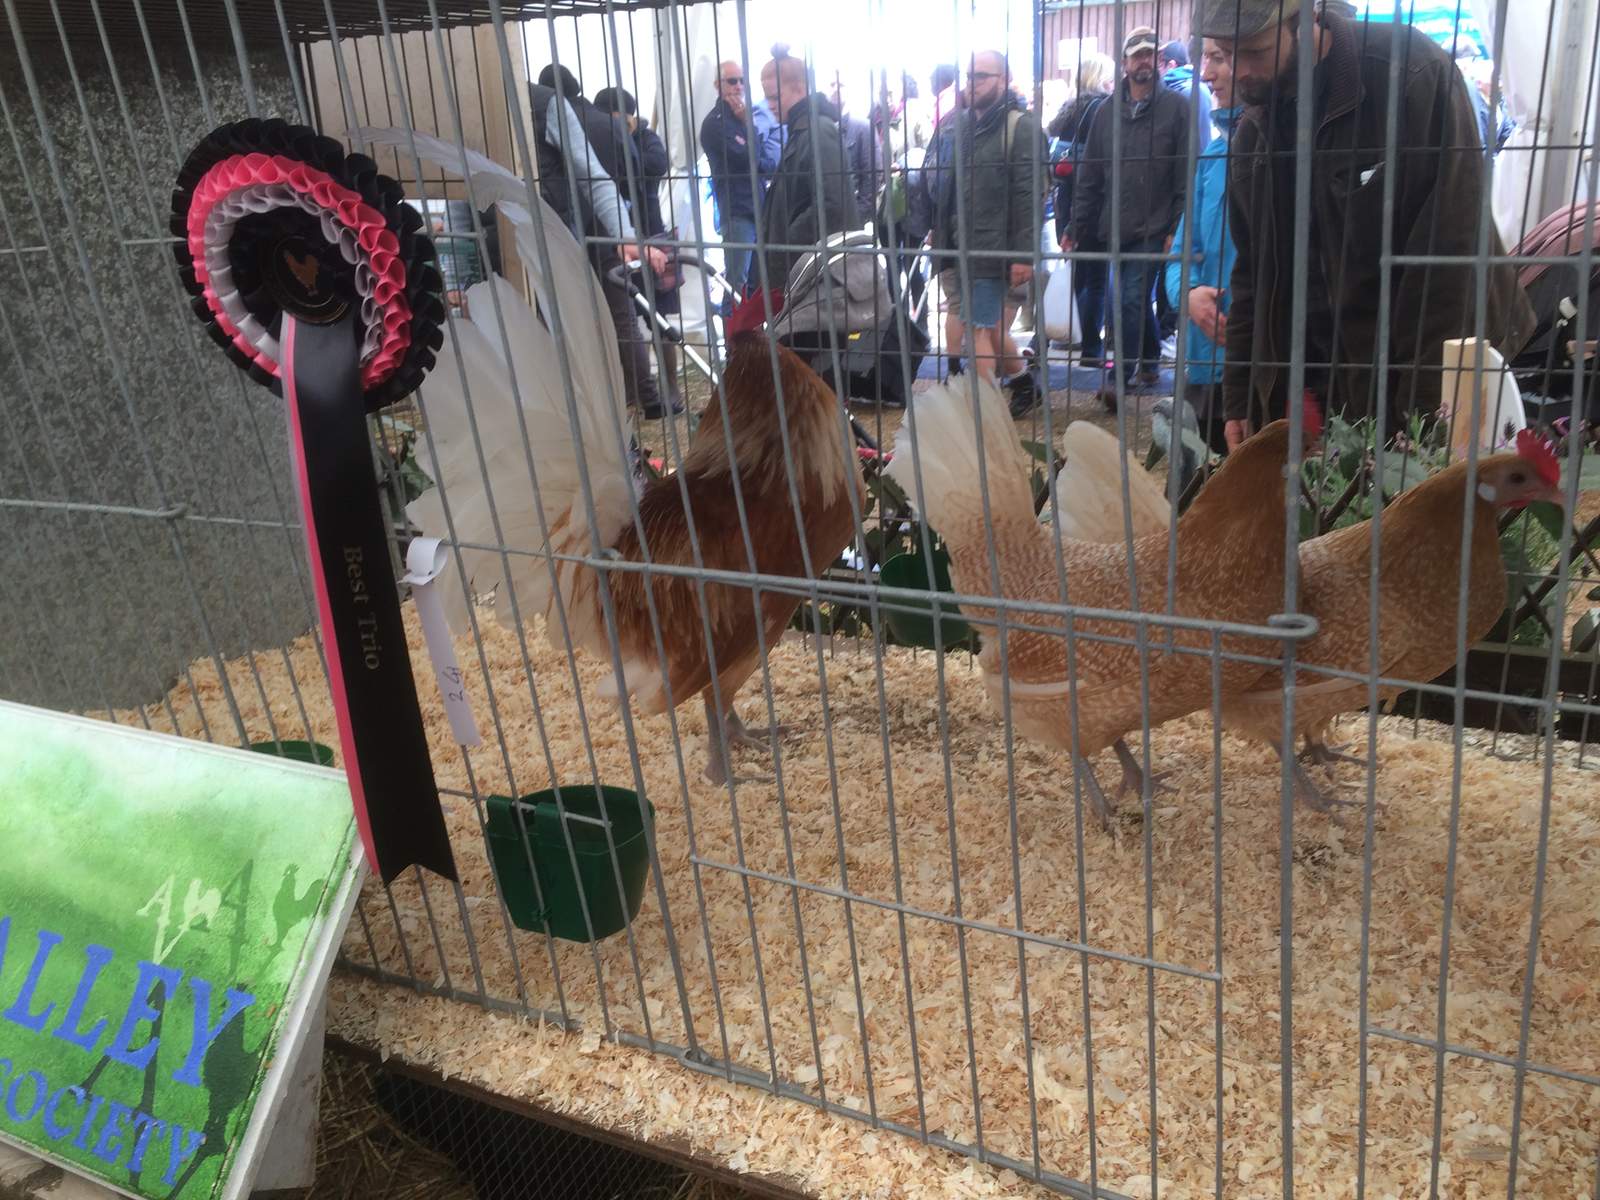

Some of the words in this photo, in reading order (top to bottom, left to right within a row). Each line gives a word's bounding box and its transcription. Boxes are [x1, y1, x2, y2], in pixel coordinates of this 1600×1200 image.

[342, 546, 369, 606] Best
[357, 611, 382, 670] Trio
[0, 917, 255, 1087] LLEY
